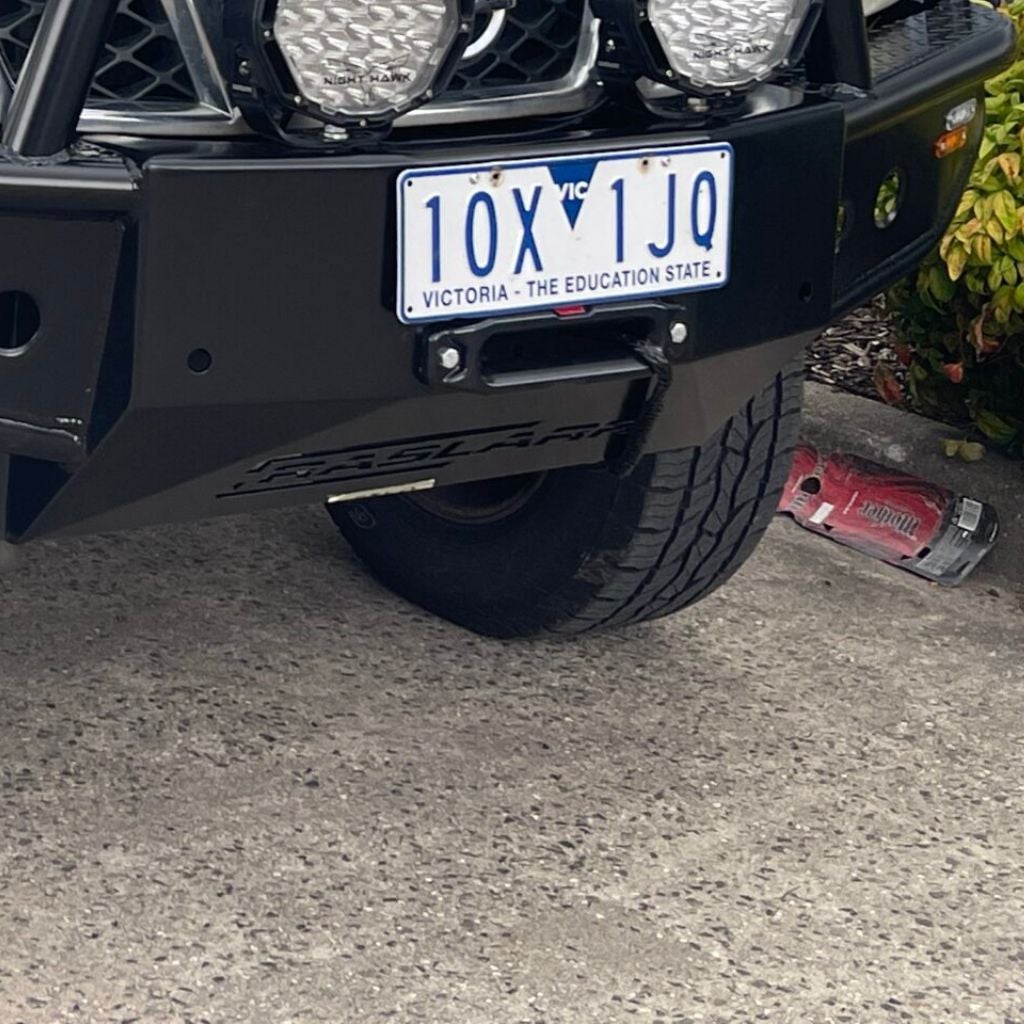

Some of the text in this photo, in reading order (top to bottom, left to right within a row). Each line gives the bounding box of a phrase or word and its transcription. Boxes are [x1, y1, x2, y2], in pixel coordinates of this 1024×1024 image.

[323, 72, 411, 86] NIGHT HAWK
[555, 181, 589, 202] VIC
[425, 185, 544, 283] 10X
[423, 284, 509, 309] VICTORIA
[526, 277, 558, 299] THE
[565, 267, 663, 294] EDUCATION
[666, 260, 712, 283] STATE
